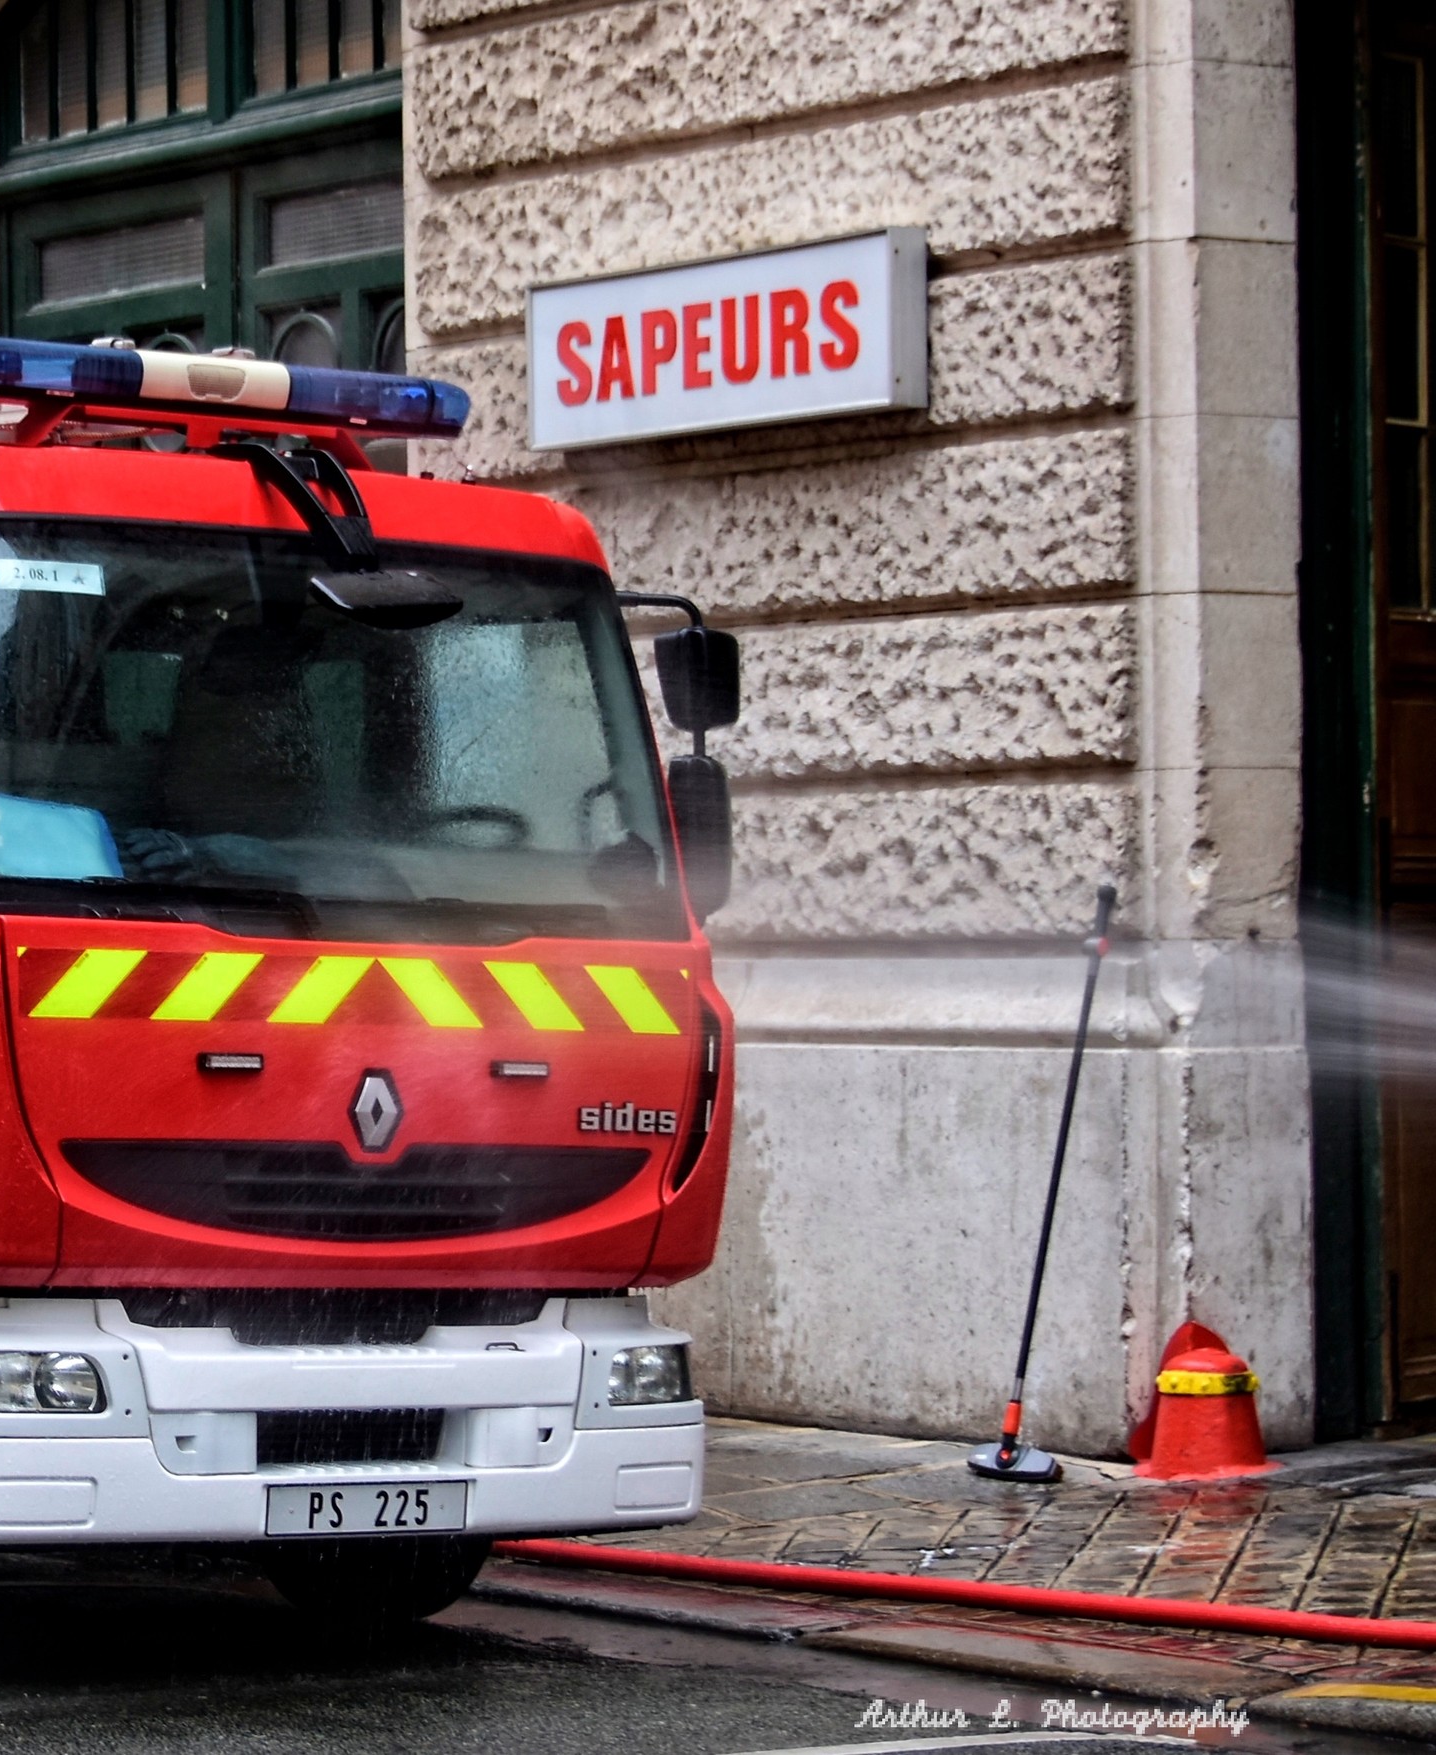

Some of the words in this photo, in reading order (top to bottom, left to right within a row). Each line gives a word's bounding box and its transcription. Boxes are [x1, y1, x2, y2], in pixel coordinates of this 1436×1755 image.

[556, 278, 861, 407] SAPEURS
[579, 1101, 678, 1134] sides
[308, 1491, 344, 1529] PS
[375, 1489, 430, 1527] 225
